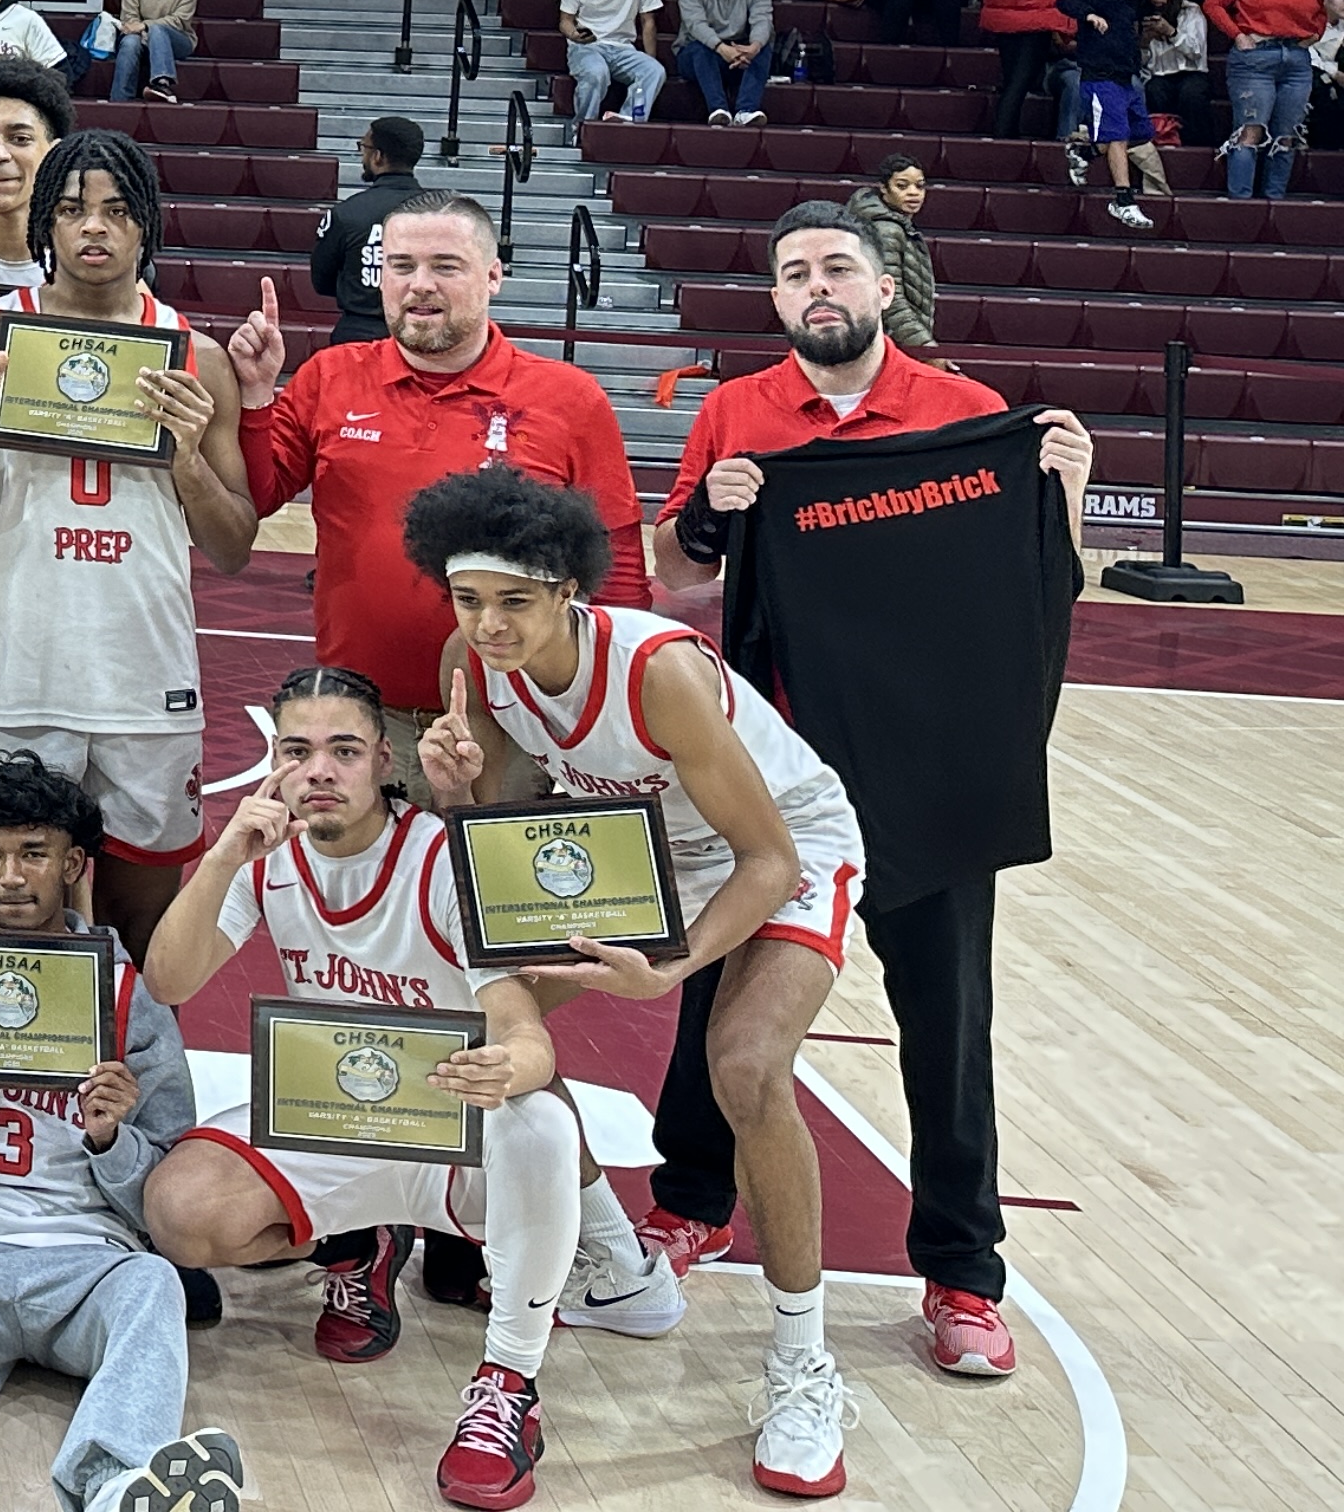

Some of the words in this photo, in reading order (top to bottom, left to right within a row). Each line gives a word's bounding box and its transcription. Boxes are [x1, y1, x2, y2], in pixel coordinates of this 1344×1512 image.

[59, 338, 118, 356] CHSAA
[340, 427, 381, 441] COACH
[794, 469, 1001, 533] #BrickbyBrick
[1084, 494, 1155, 517] RAMS
[54, 527, 132, 564] PREP
[525, 822, 591, 840] CHSAA
[315, 954, 434, 1009] JOHN'S
[334, 1032, 405, 1050] CHSAA
